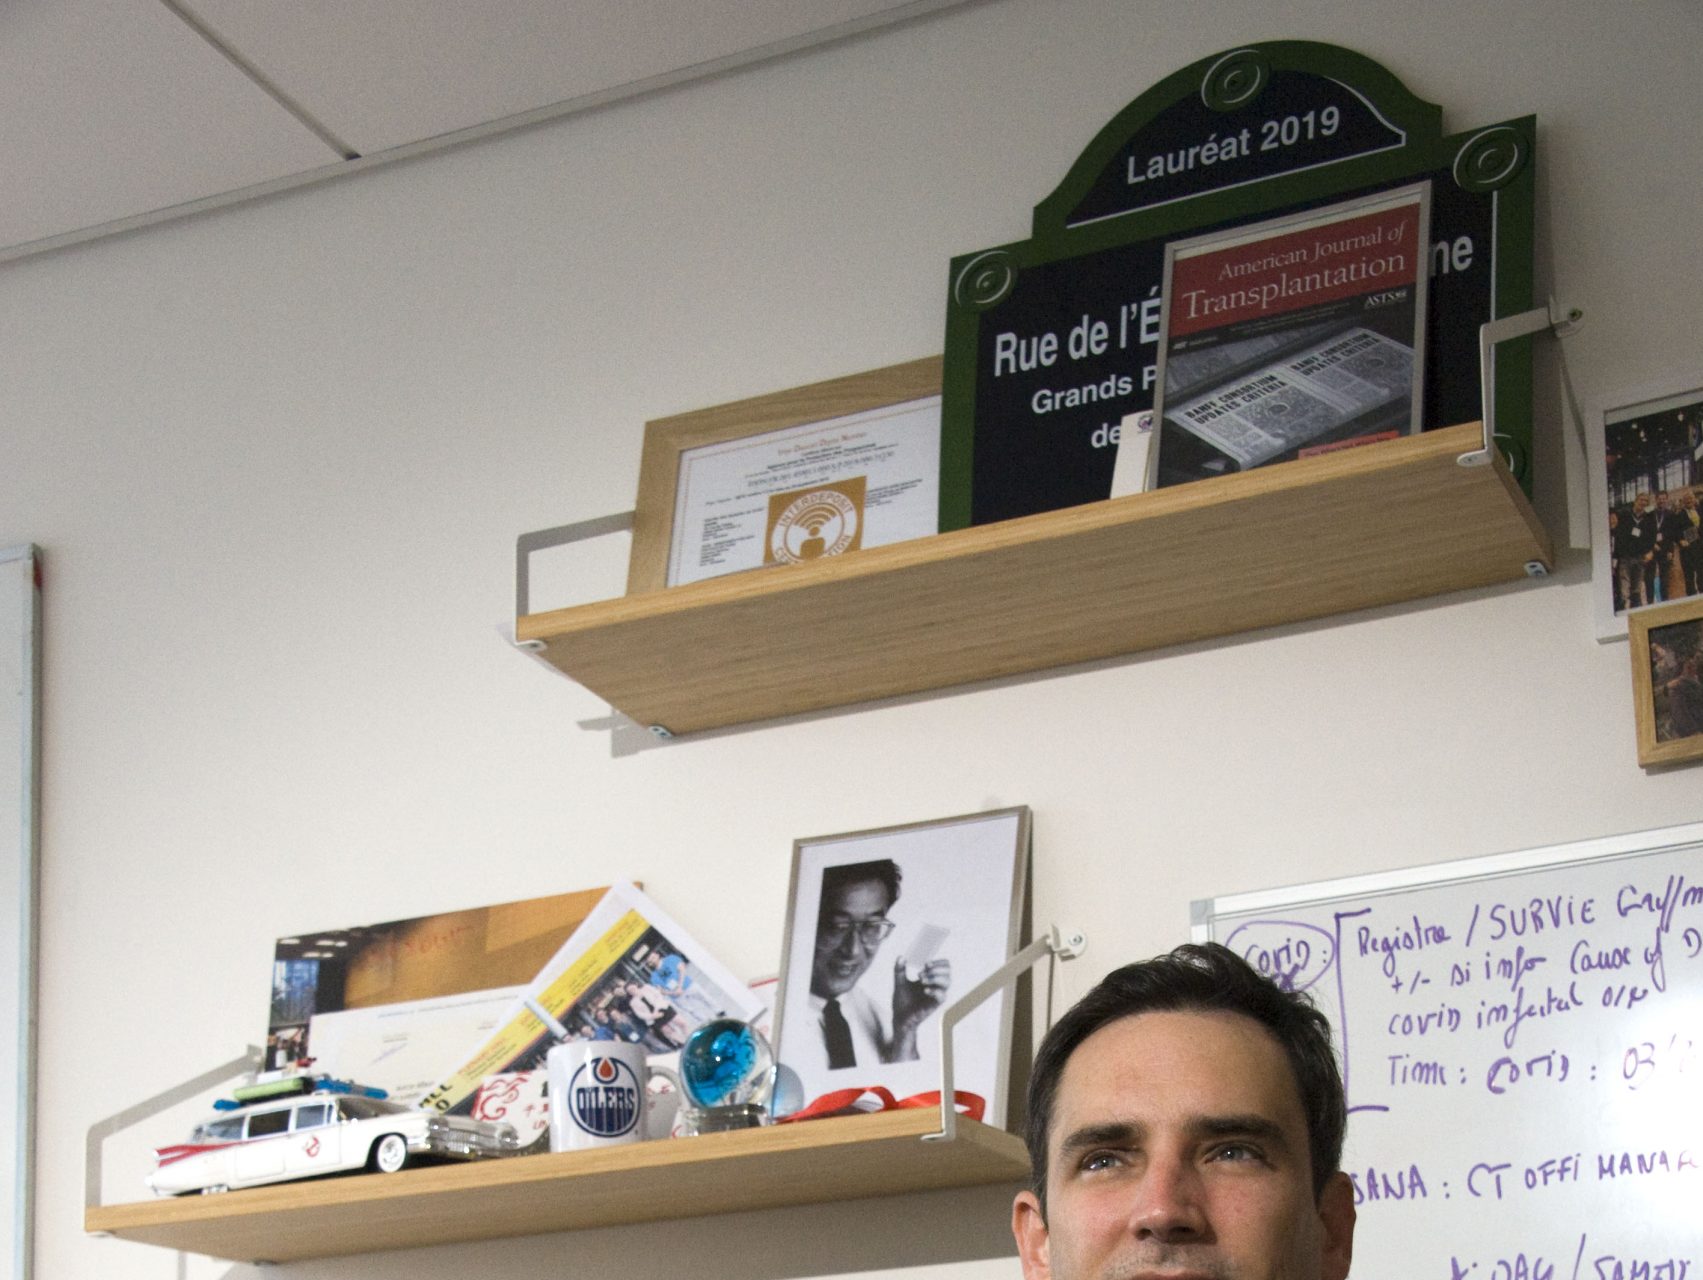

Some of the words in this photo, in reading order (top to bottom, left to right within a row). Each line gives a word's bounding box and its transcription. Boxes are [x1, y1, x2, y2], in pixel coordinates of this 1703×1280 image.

[1127, 128, 1250, 185] Lauréat
[1260, 106, 1340, 151] 2019
[1218, 246, 1307, 281] American
[1311, 226, 1383, 264] Journal
[1388, 220, 1409, 243] of
[1181, 254, 1406, 319] Transplantation
[994, 331, 1059, 377] Rue
[1068, 314, 1109, 360] de
[1031, 374, 1133, 414] Grands
[576, 1087, 635, 1133] OILERS
